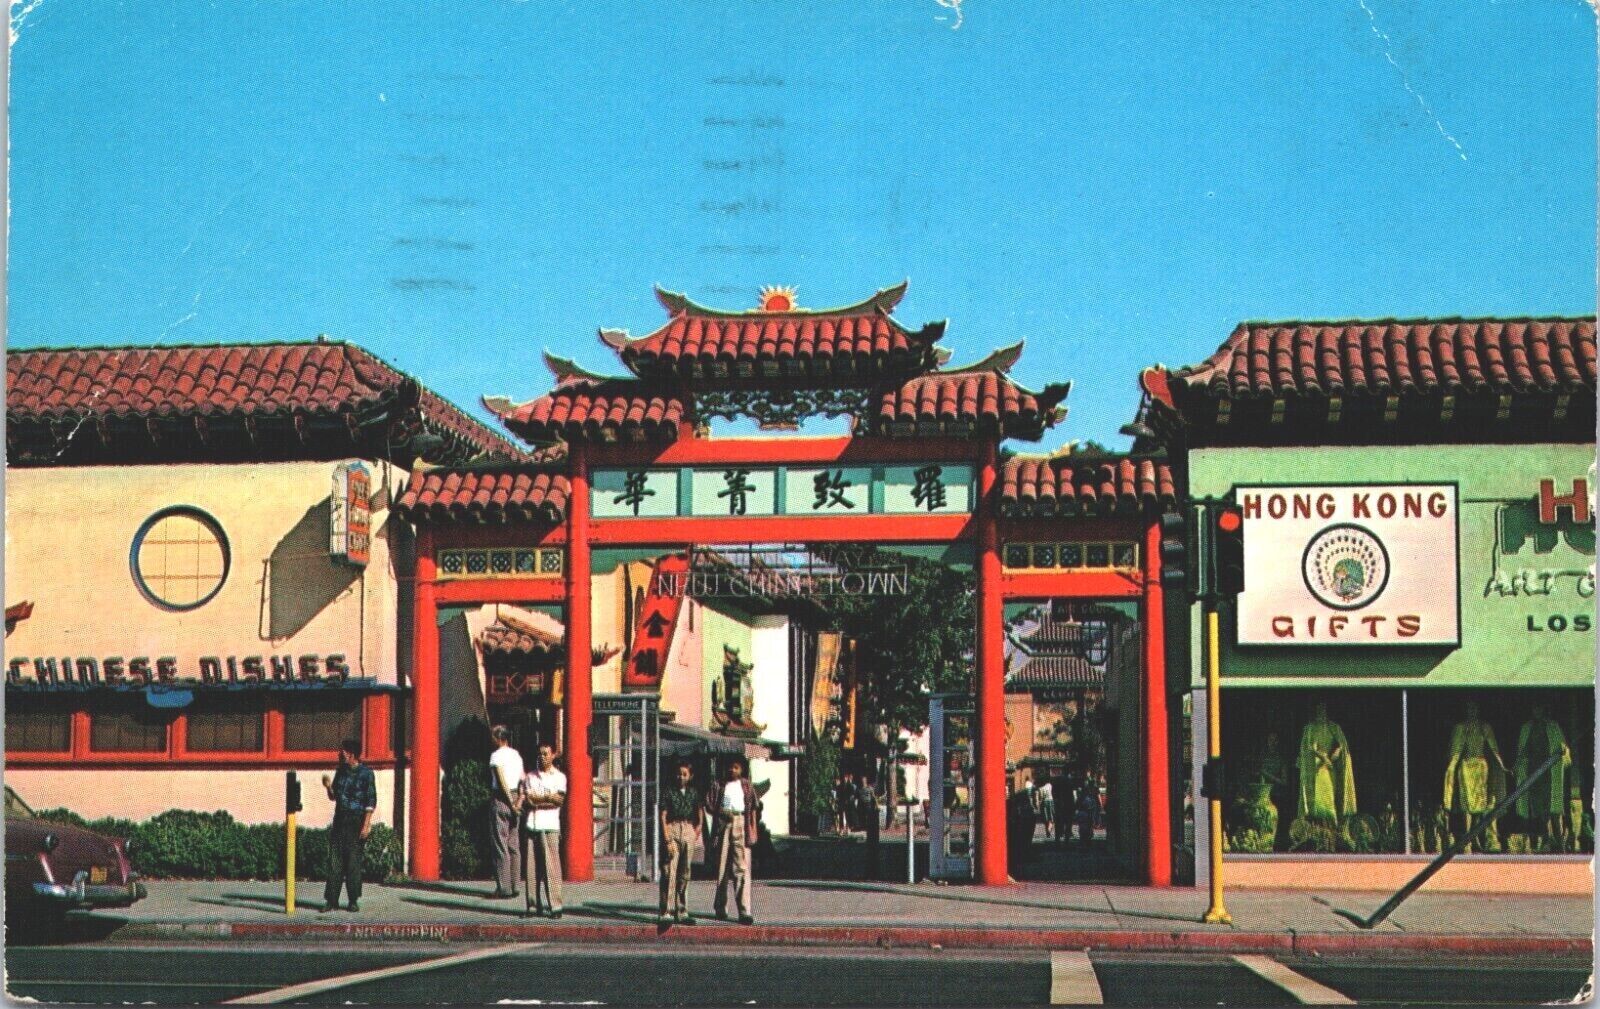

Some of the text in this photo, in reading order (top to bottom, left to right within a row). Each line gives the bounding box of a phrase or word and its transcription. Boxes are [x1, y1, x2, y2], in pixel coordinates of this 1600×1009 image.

[1243, 491, 1448, 520] HONG KONG
[658, 572, 718, 598] NEW
[1271, 615, 1422, 639] GIFTS
[1526, 614, 1592, 633] LOS
[8, 653, 350, 687] CHINESE DISHES
